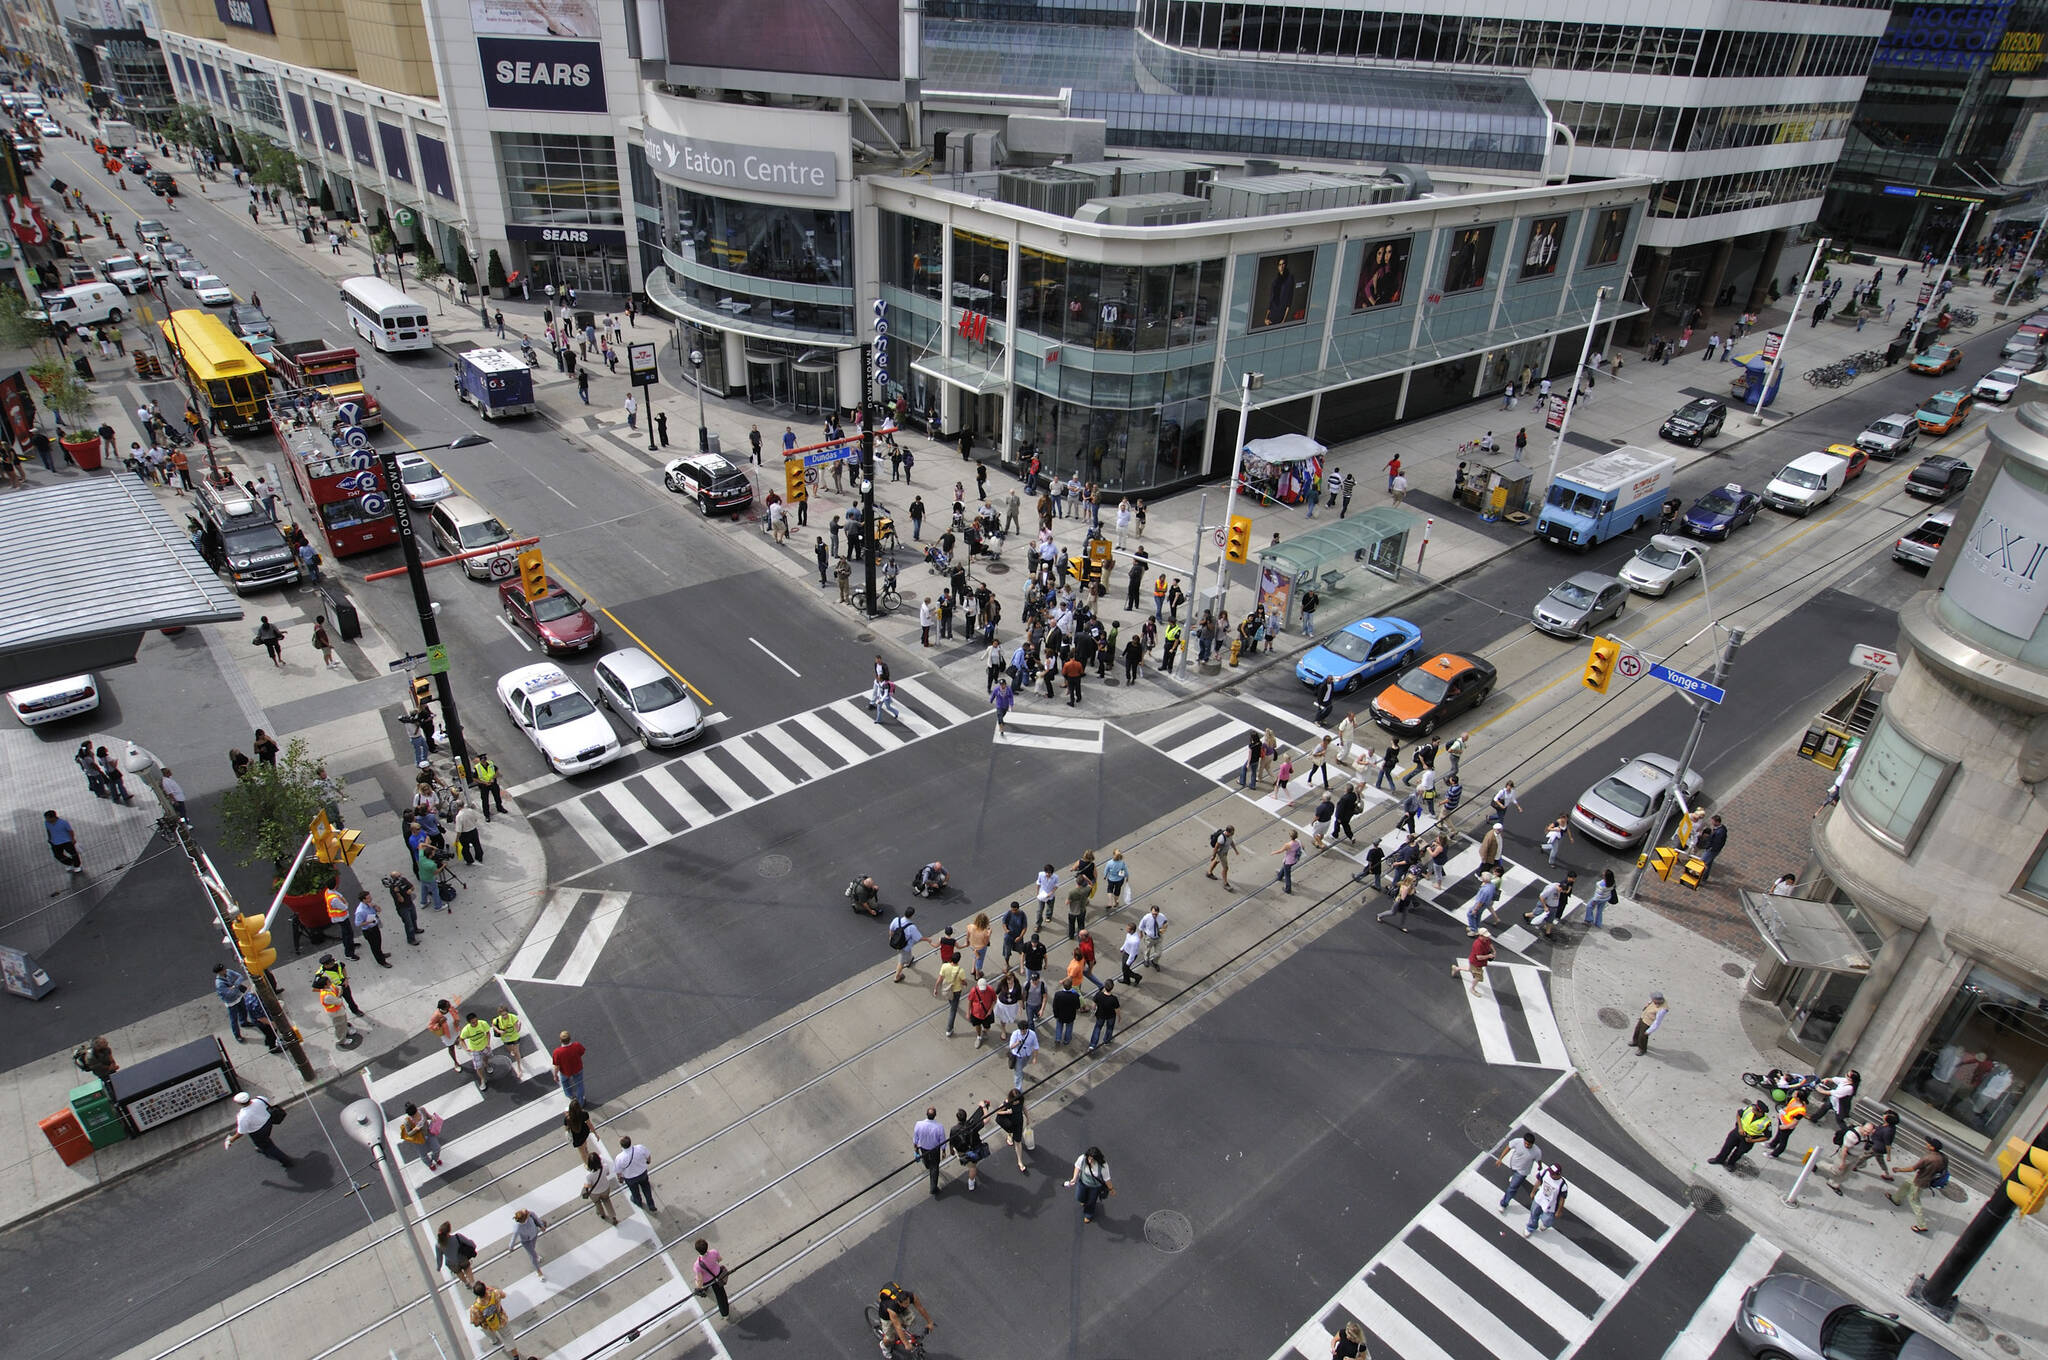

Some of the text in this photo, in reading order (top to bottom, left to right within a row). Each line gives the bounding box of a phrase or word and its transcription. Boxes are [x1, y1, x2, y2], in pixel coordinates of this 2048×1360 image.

[1879, 27, 1959, 49] CHOOL
[2001, 31, 2044, 51] RYERSON
[1991, 52, 2048, 72] UNIVERSITY
[496, 60, 590, 87] SEARS
[684, 147, 736, 178] Eaton
[743, 155, 825, 187] Centre
[542, 229, 588, 242] SEARS
[958, 310, 988, 345] H&M
[339, 403, 386, 516] Yonge
[811, 452, 837, 463] Dundas
[387, 460, 412, 536] DOWNTOWN
[250, 552, 287, 564] ROGERS
[1667, 670, 1698, 690] Yonge
